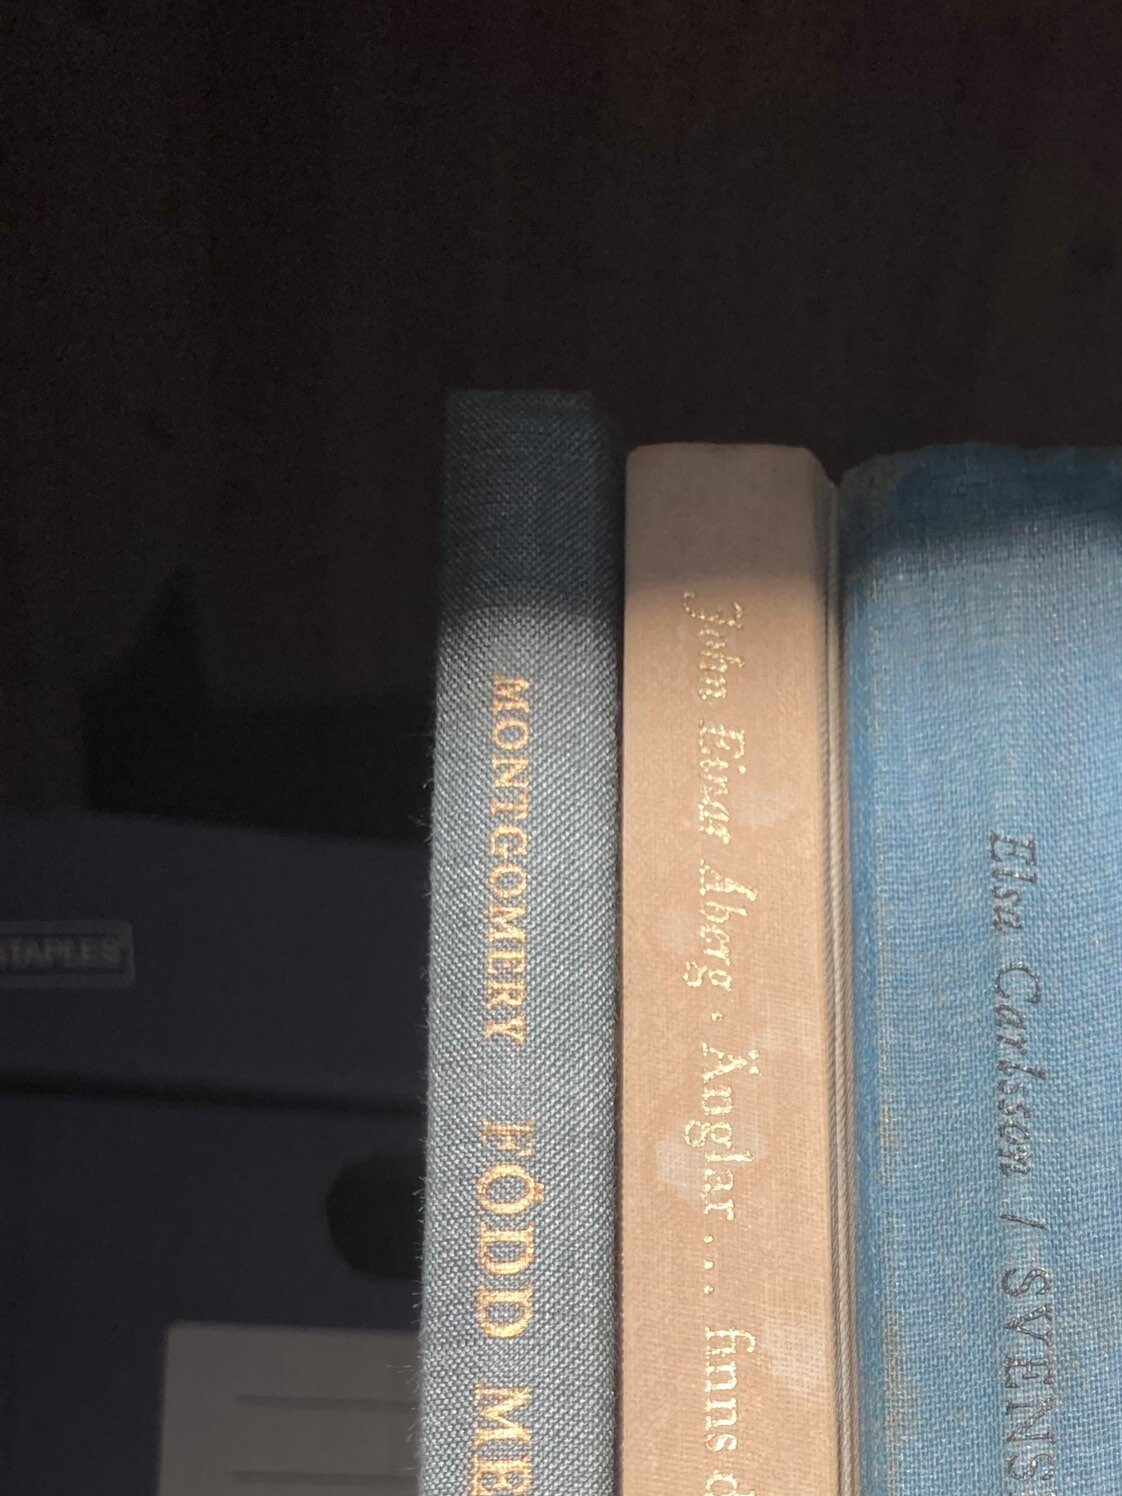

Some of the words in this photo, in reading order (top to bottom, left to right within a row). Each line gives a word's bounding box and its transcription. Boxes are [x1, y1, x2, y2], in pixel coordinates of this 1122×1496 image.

[681, 591, 745, 702] John
[697, 717, 747, 845] Einar
[484, 674, 530, 1046] MONTGOMERY
[988, 829, 1039, 932] Elsa
[993, 959, 1048, 1177] Carlsson
[474, 1117, 545, 1341] FÖDD
[704, 1326, 757, 1453] finns
